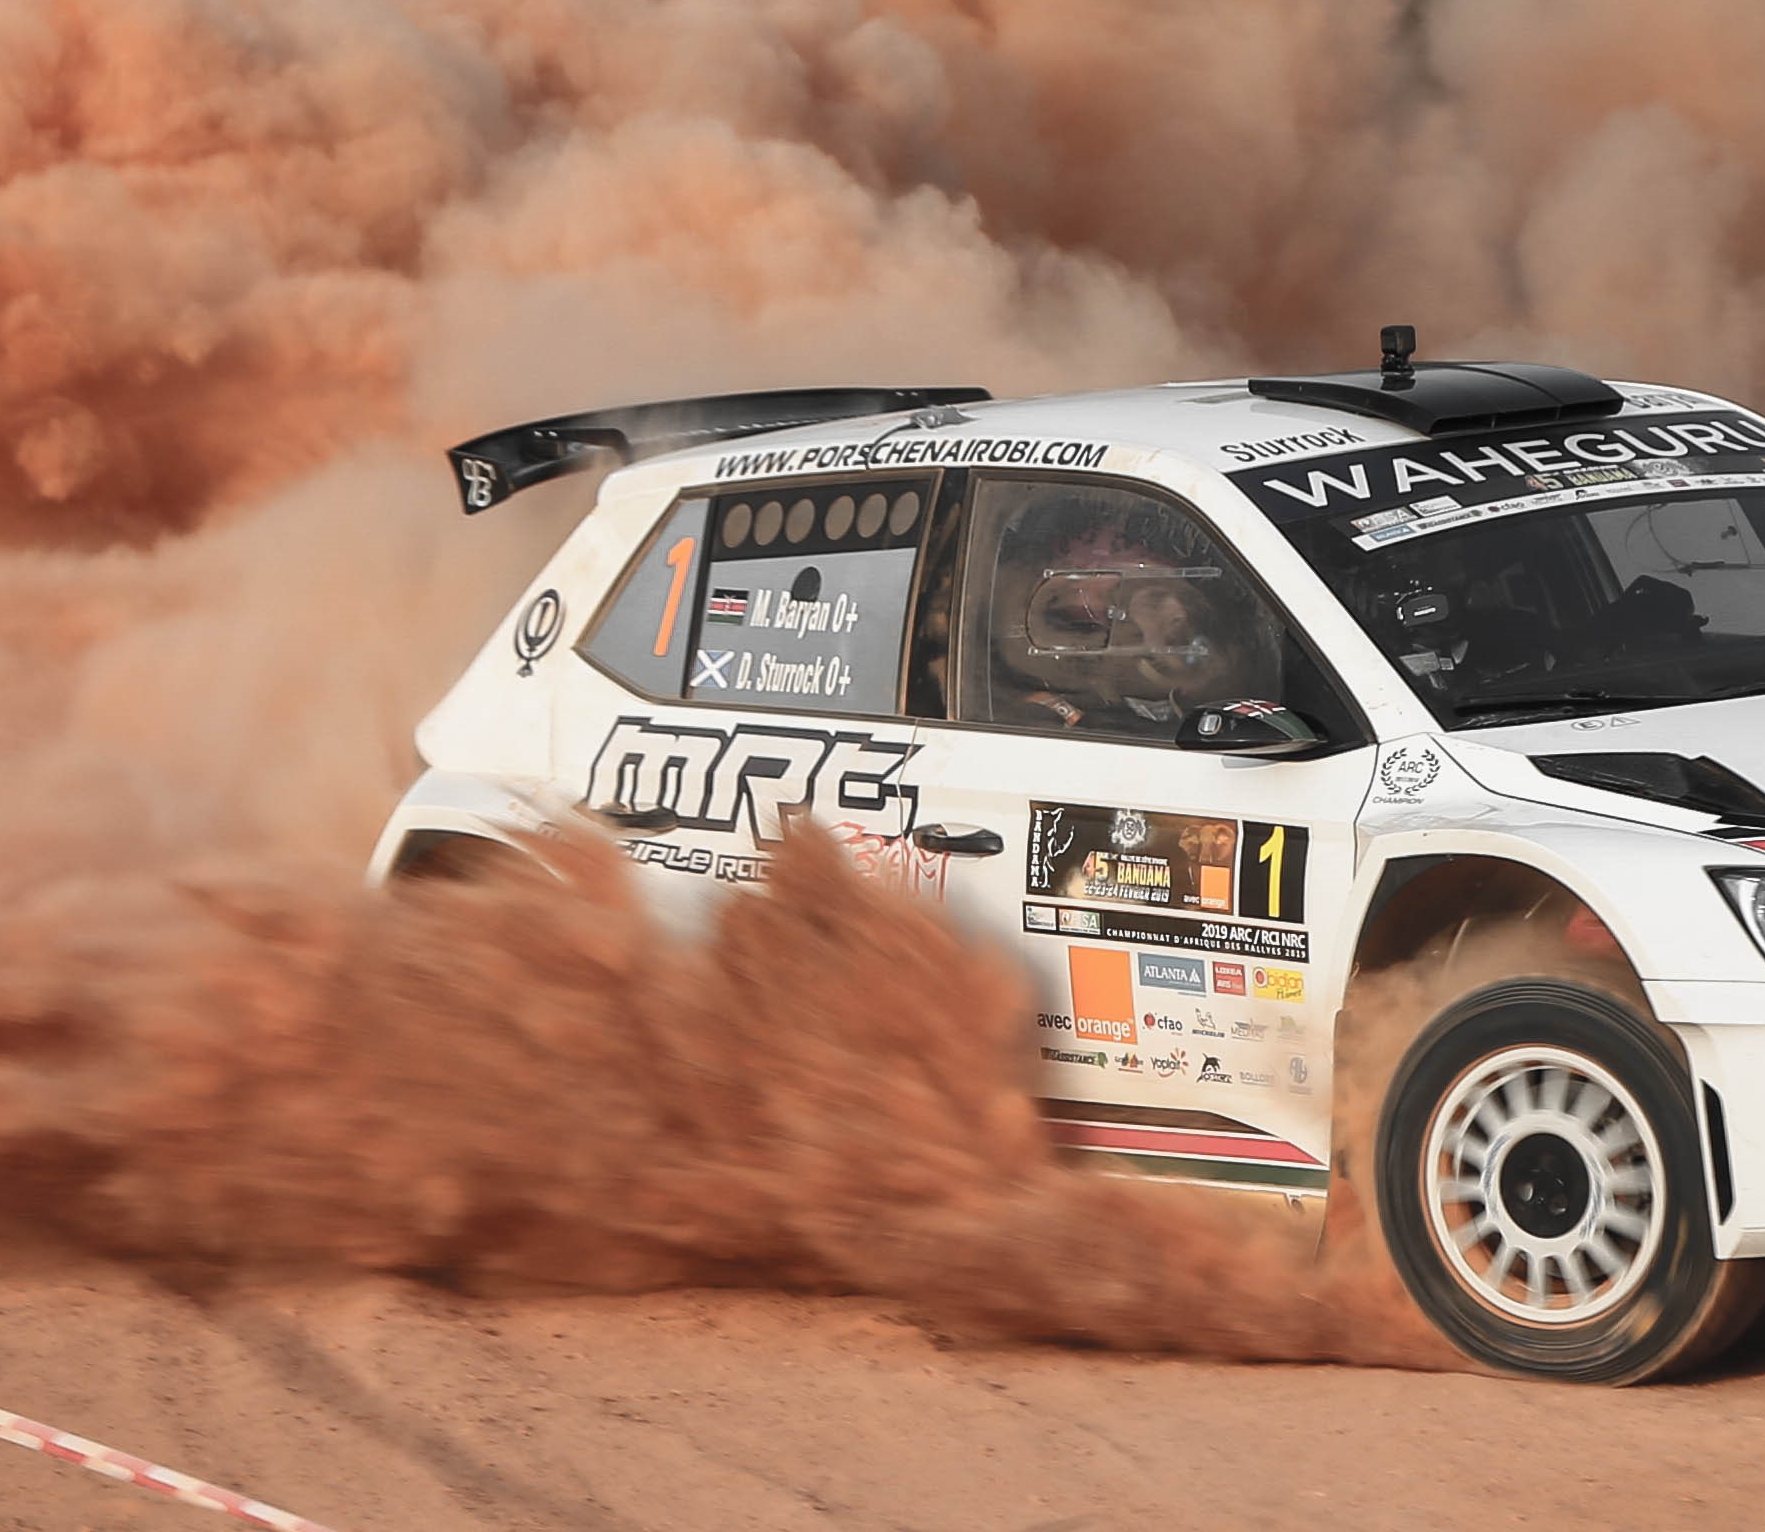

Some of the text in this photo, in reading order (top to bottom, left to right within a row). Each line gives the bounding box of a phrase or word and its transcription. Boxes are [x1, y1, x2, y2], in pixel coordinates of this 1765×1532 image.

[715, 439, 1108, 478] WWW.PORSCHENAIROBI.COM
[1221, 426, 1366, 462] Sturrock
[653, 536, 696, 657] 1
[750, 589, 772, 628] M.
[774, 590, 831, 639] Baryan
[735, 651, 752, 689] D.
[756, 652, 825, 695] Sturrock
[1397, 761, 1424, 774] ARC
[1117, 861, 1171, 888] BANDAMA
[1259, 825, 1285, 918] 1
[1106, 927, 1306, 958] CHAMPIONNAT D'AFRIQUE DES RALLYES 2019
[1201, 923, 1228, 940] 2019
[1229, 926, 1254, 943] ARC
[1253, 929, 1261, 945] /
[1281, 932, 1306, 949] NRC
[1143, 965, 1188, 982] ATLANTA
[1036, 1012, 1131, 1041] avec orange
[1157, 1016, 1184, 1031] cfao
[1150, 1055, 1181, 1070] Yoplait
